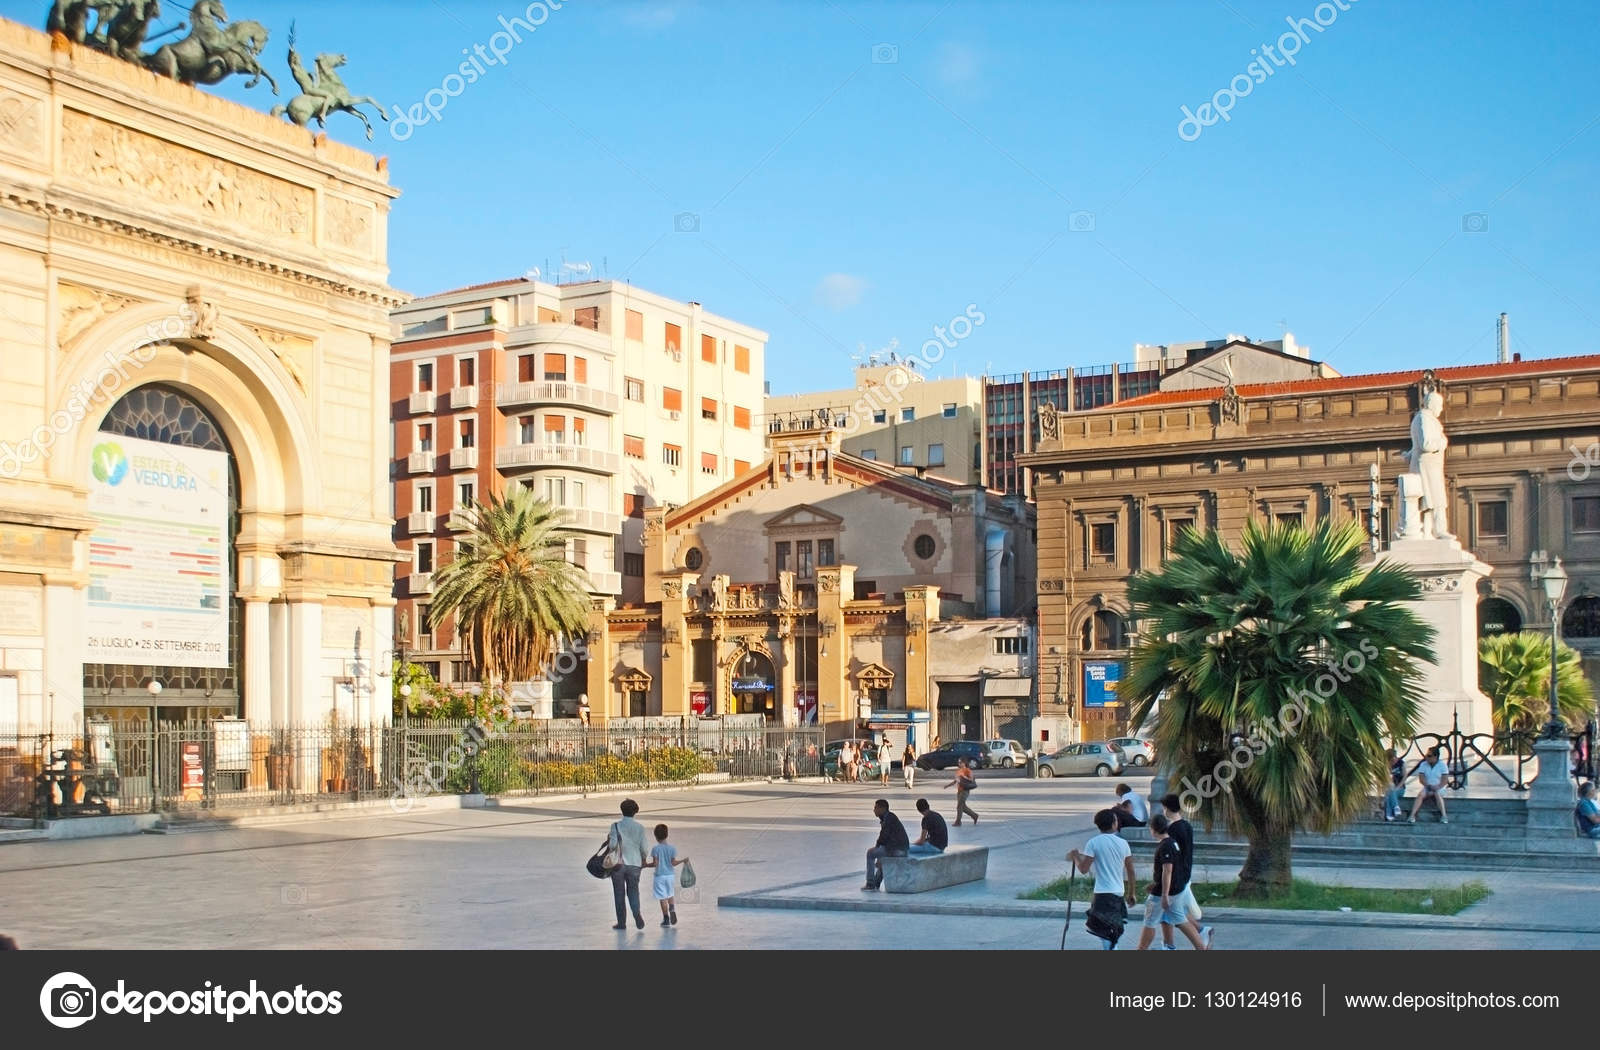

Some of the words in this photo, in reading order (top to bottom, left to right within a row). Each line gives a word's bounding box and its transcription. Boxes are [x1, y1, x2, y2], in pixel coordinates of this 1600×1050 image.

[132, 455, 173, 472] ESTATE
[133, 469, 198, 492] VERDURA
[101, 637, 134, 649] LUGLIO
[141, 639, 152, 650] 25
[153, 639, 202, 652] SETTEMBRE
[204, 641, 222, 653] 2012
